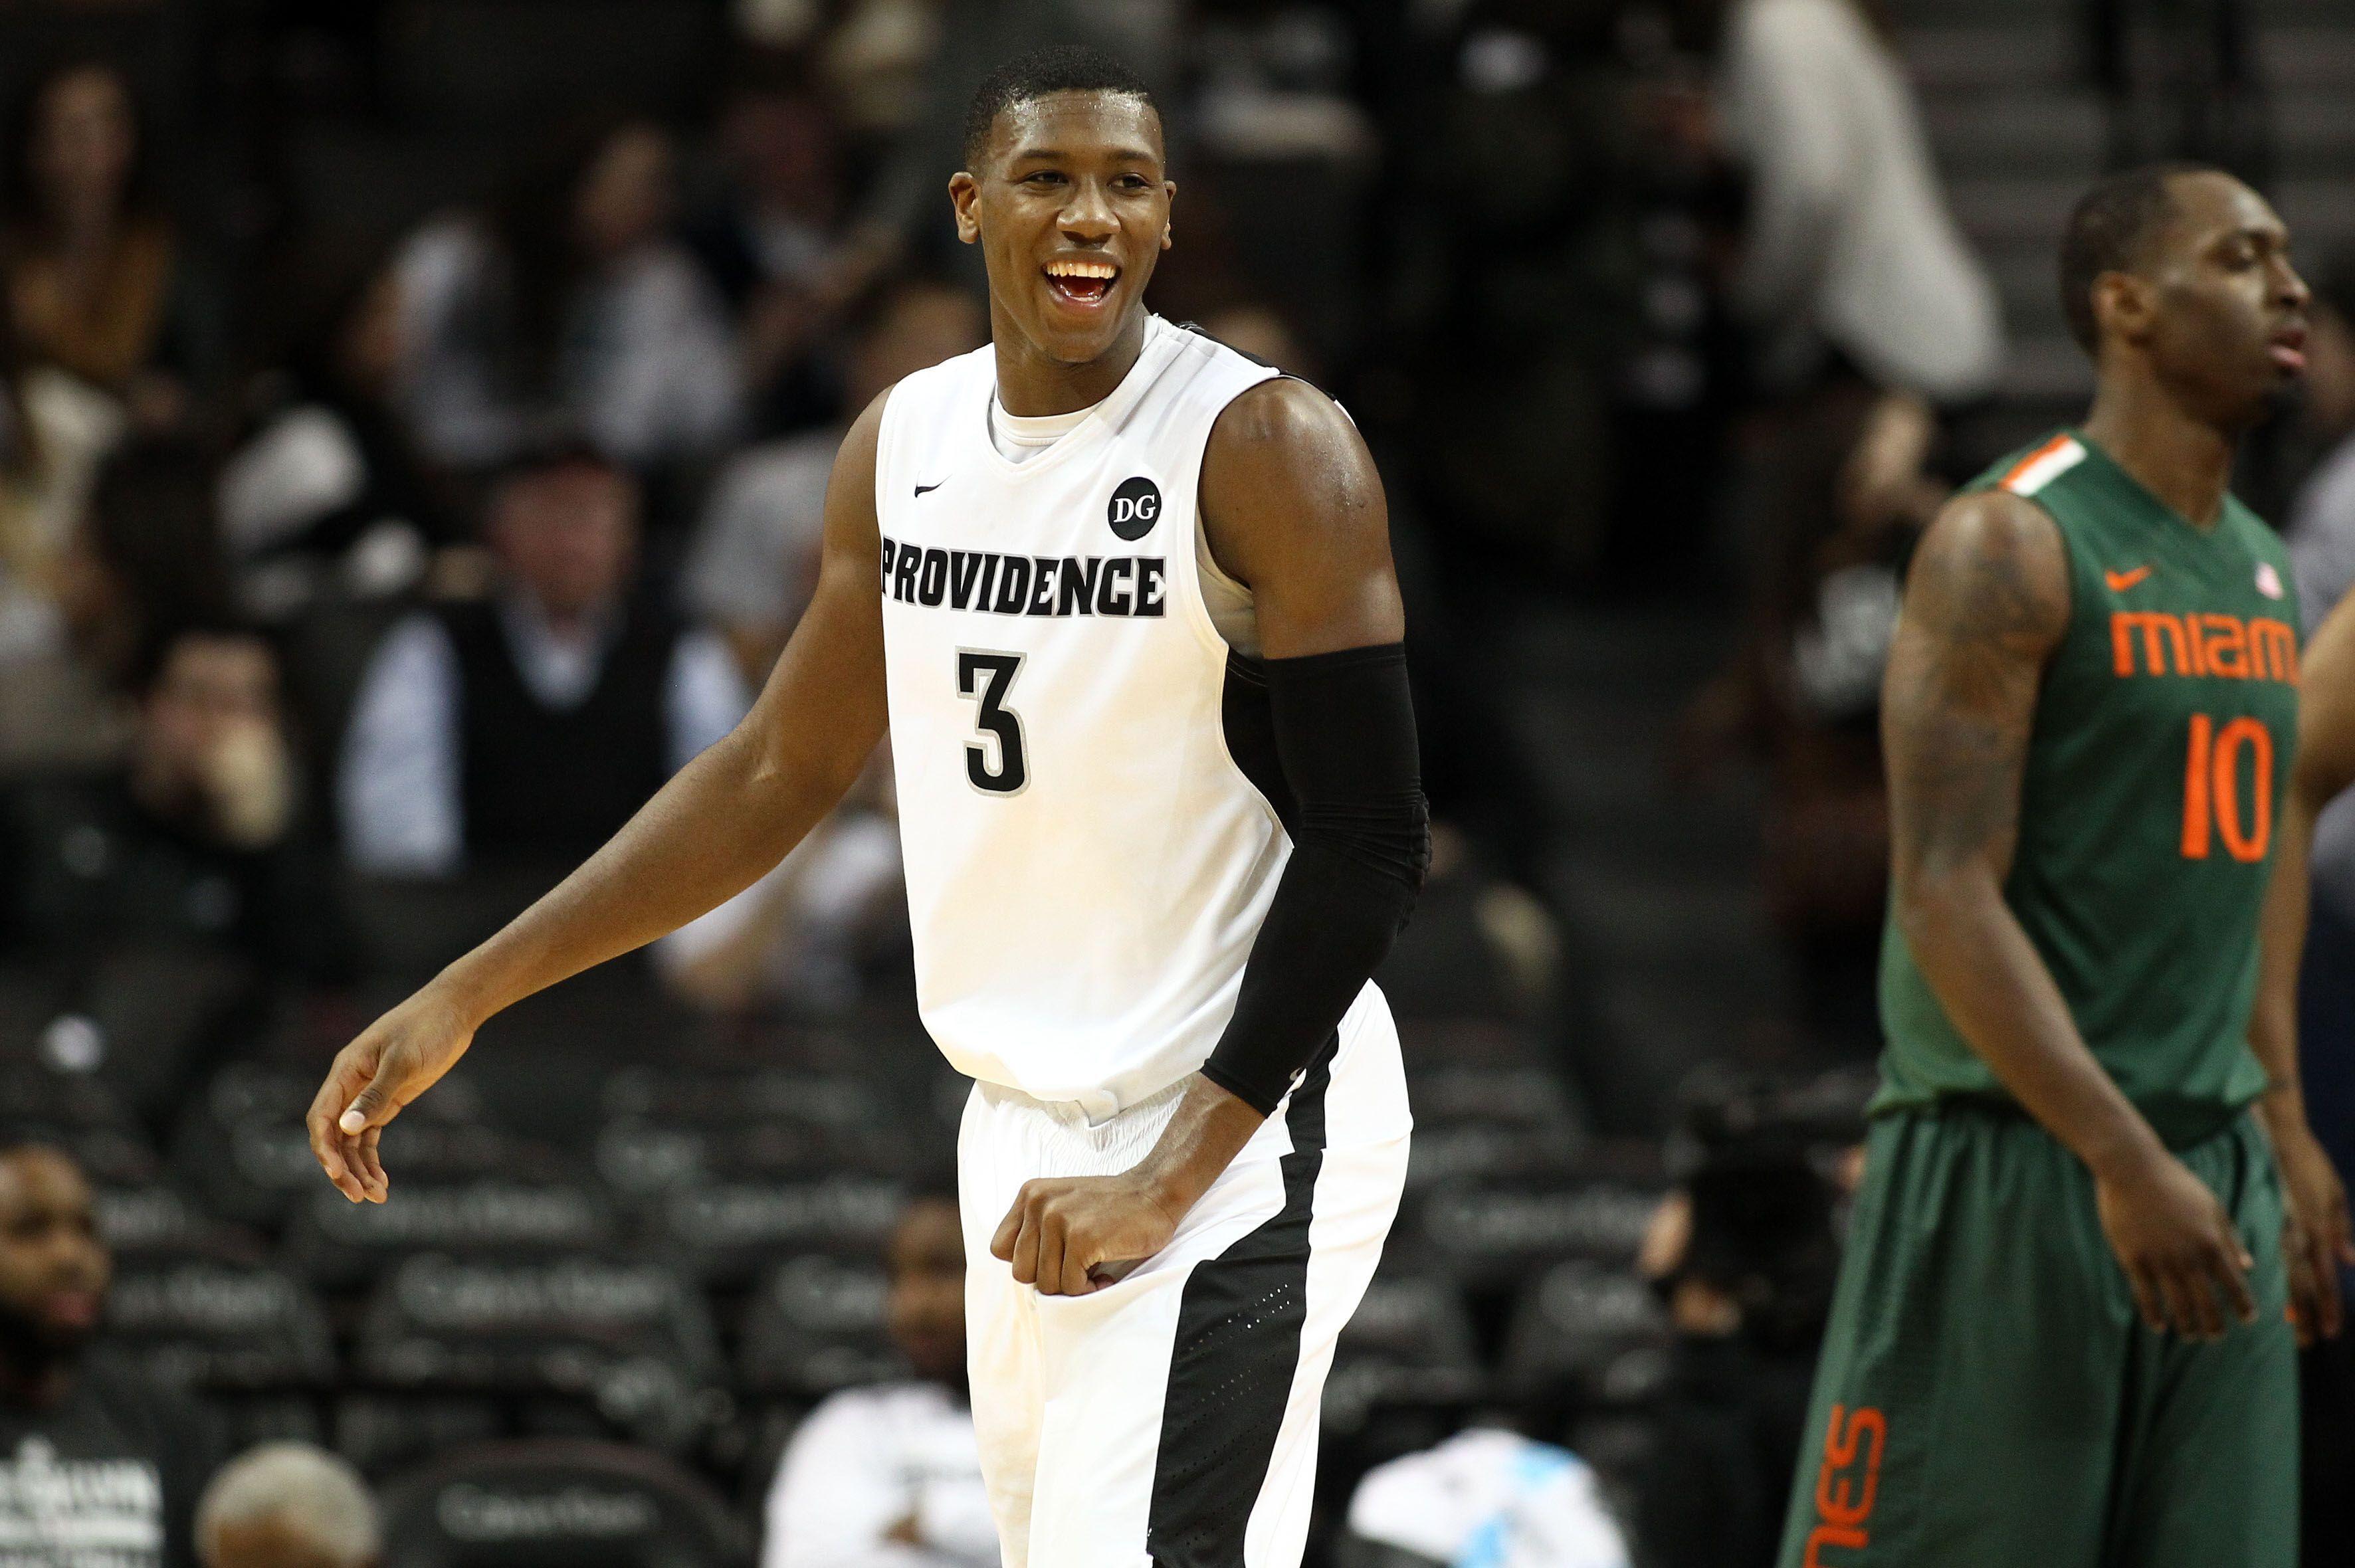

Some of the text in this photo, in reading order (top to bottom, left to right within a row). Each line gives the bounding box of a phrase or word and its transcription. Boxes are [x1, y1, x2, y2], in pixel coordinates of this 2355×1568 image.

[1113, 494, 1157, 524] DG
[882, 534, 1168, 619] PROVIDENCE
[955, 645, 1031, 799] 3
[2180, 712, 2273, 862] 10
